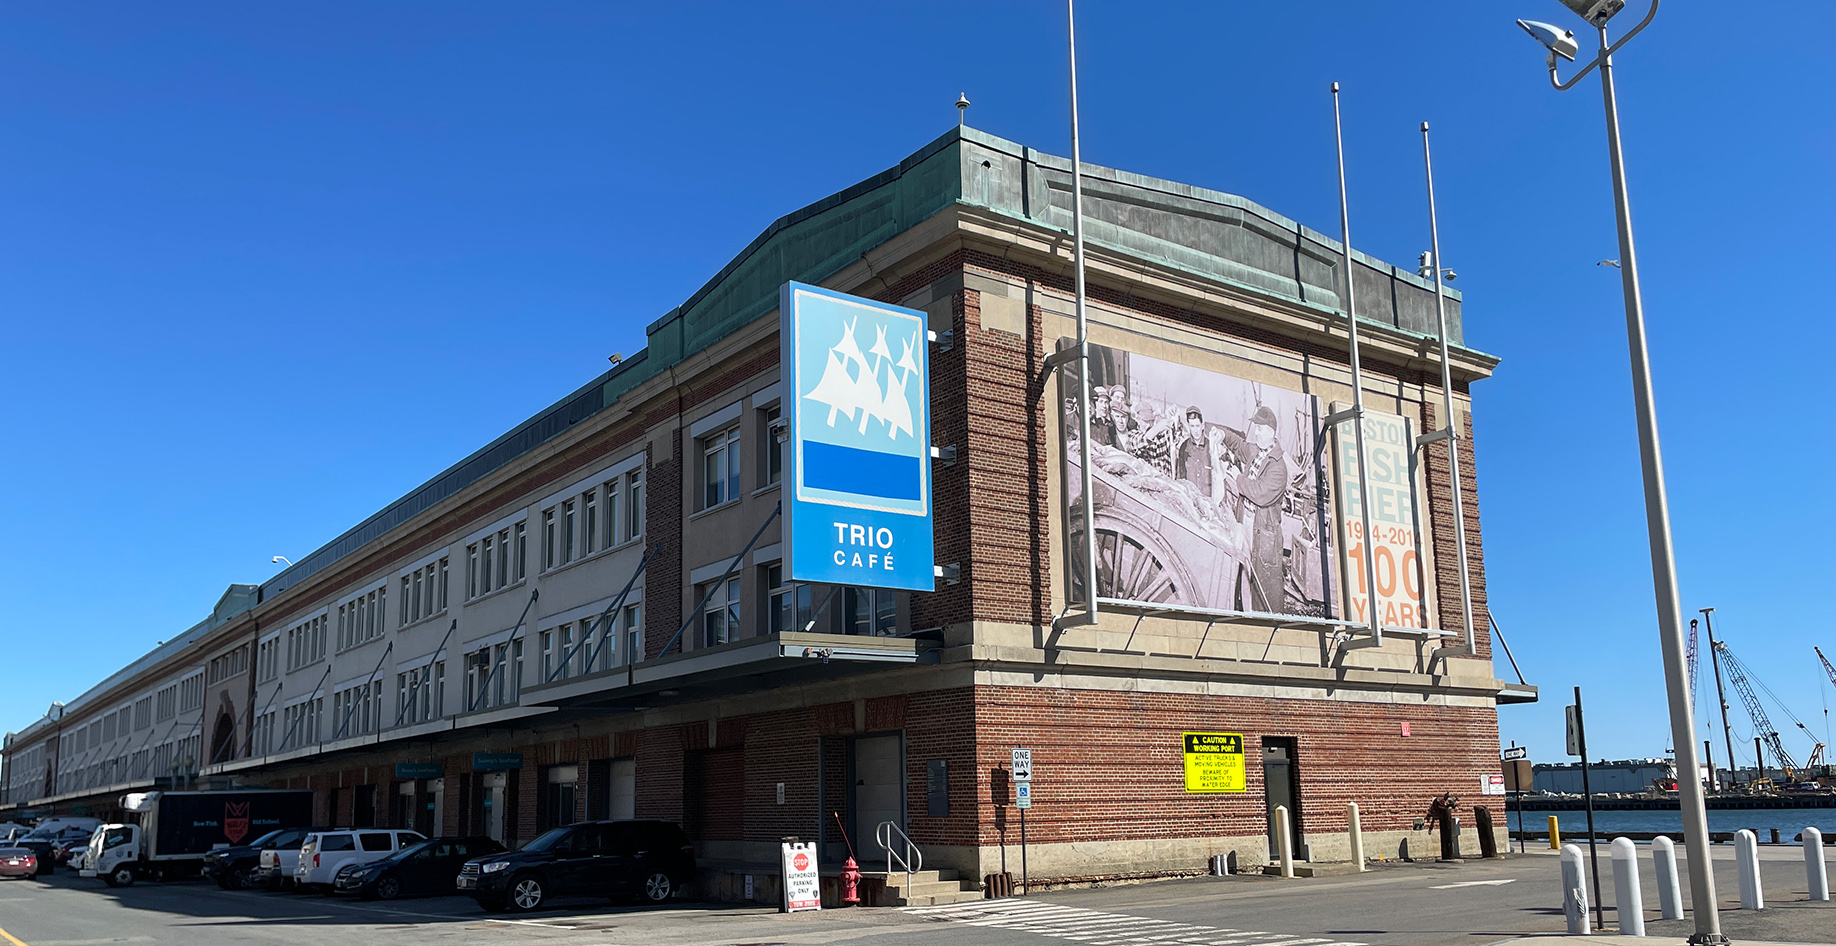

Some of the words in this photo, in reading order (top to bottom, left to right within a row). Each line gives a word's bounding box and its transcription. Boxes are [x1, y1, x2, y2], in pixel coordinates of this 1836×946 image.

[1342, 418, 1410, 447] BSTON
[833, 522, 893, 549] TRIO
[1346, 520, 1423, 547] 194-2014
[833, 550, 894, 570] CAFÉ
[1349, 542, 1425, 601] 100
[1014, 751, 1029, 760] ONE
[794, 858, 808, 866] STOP
